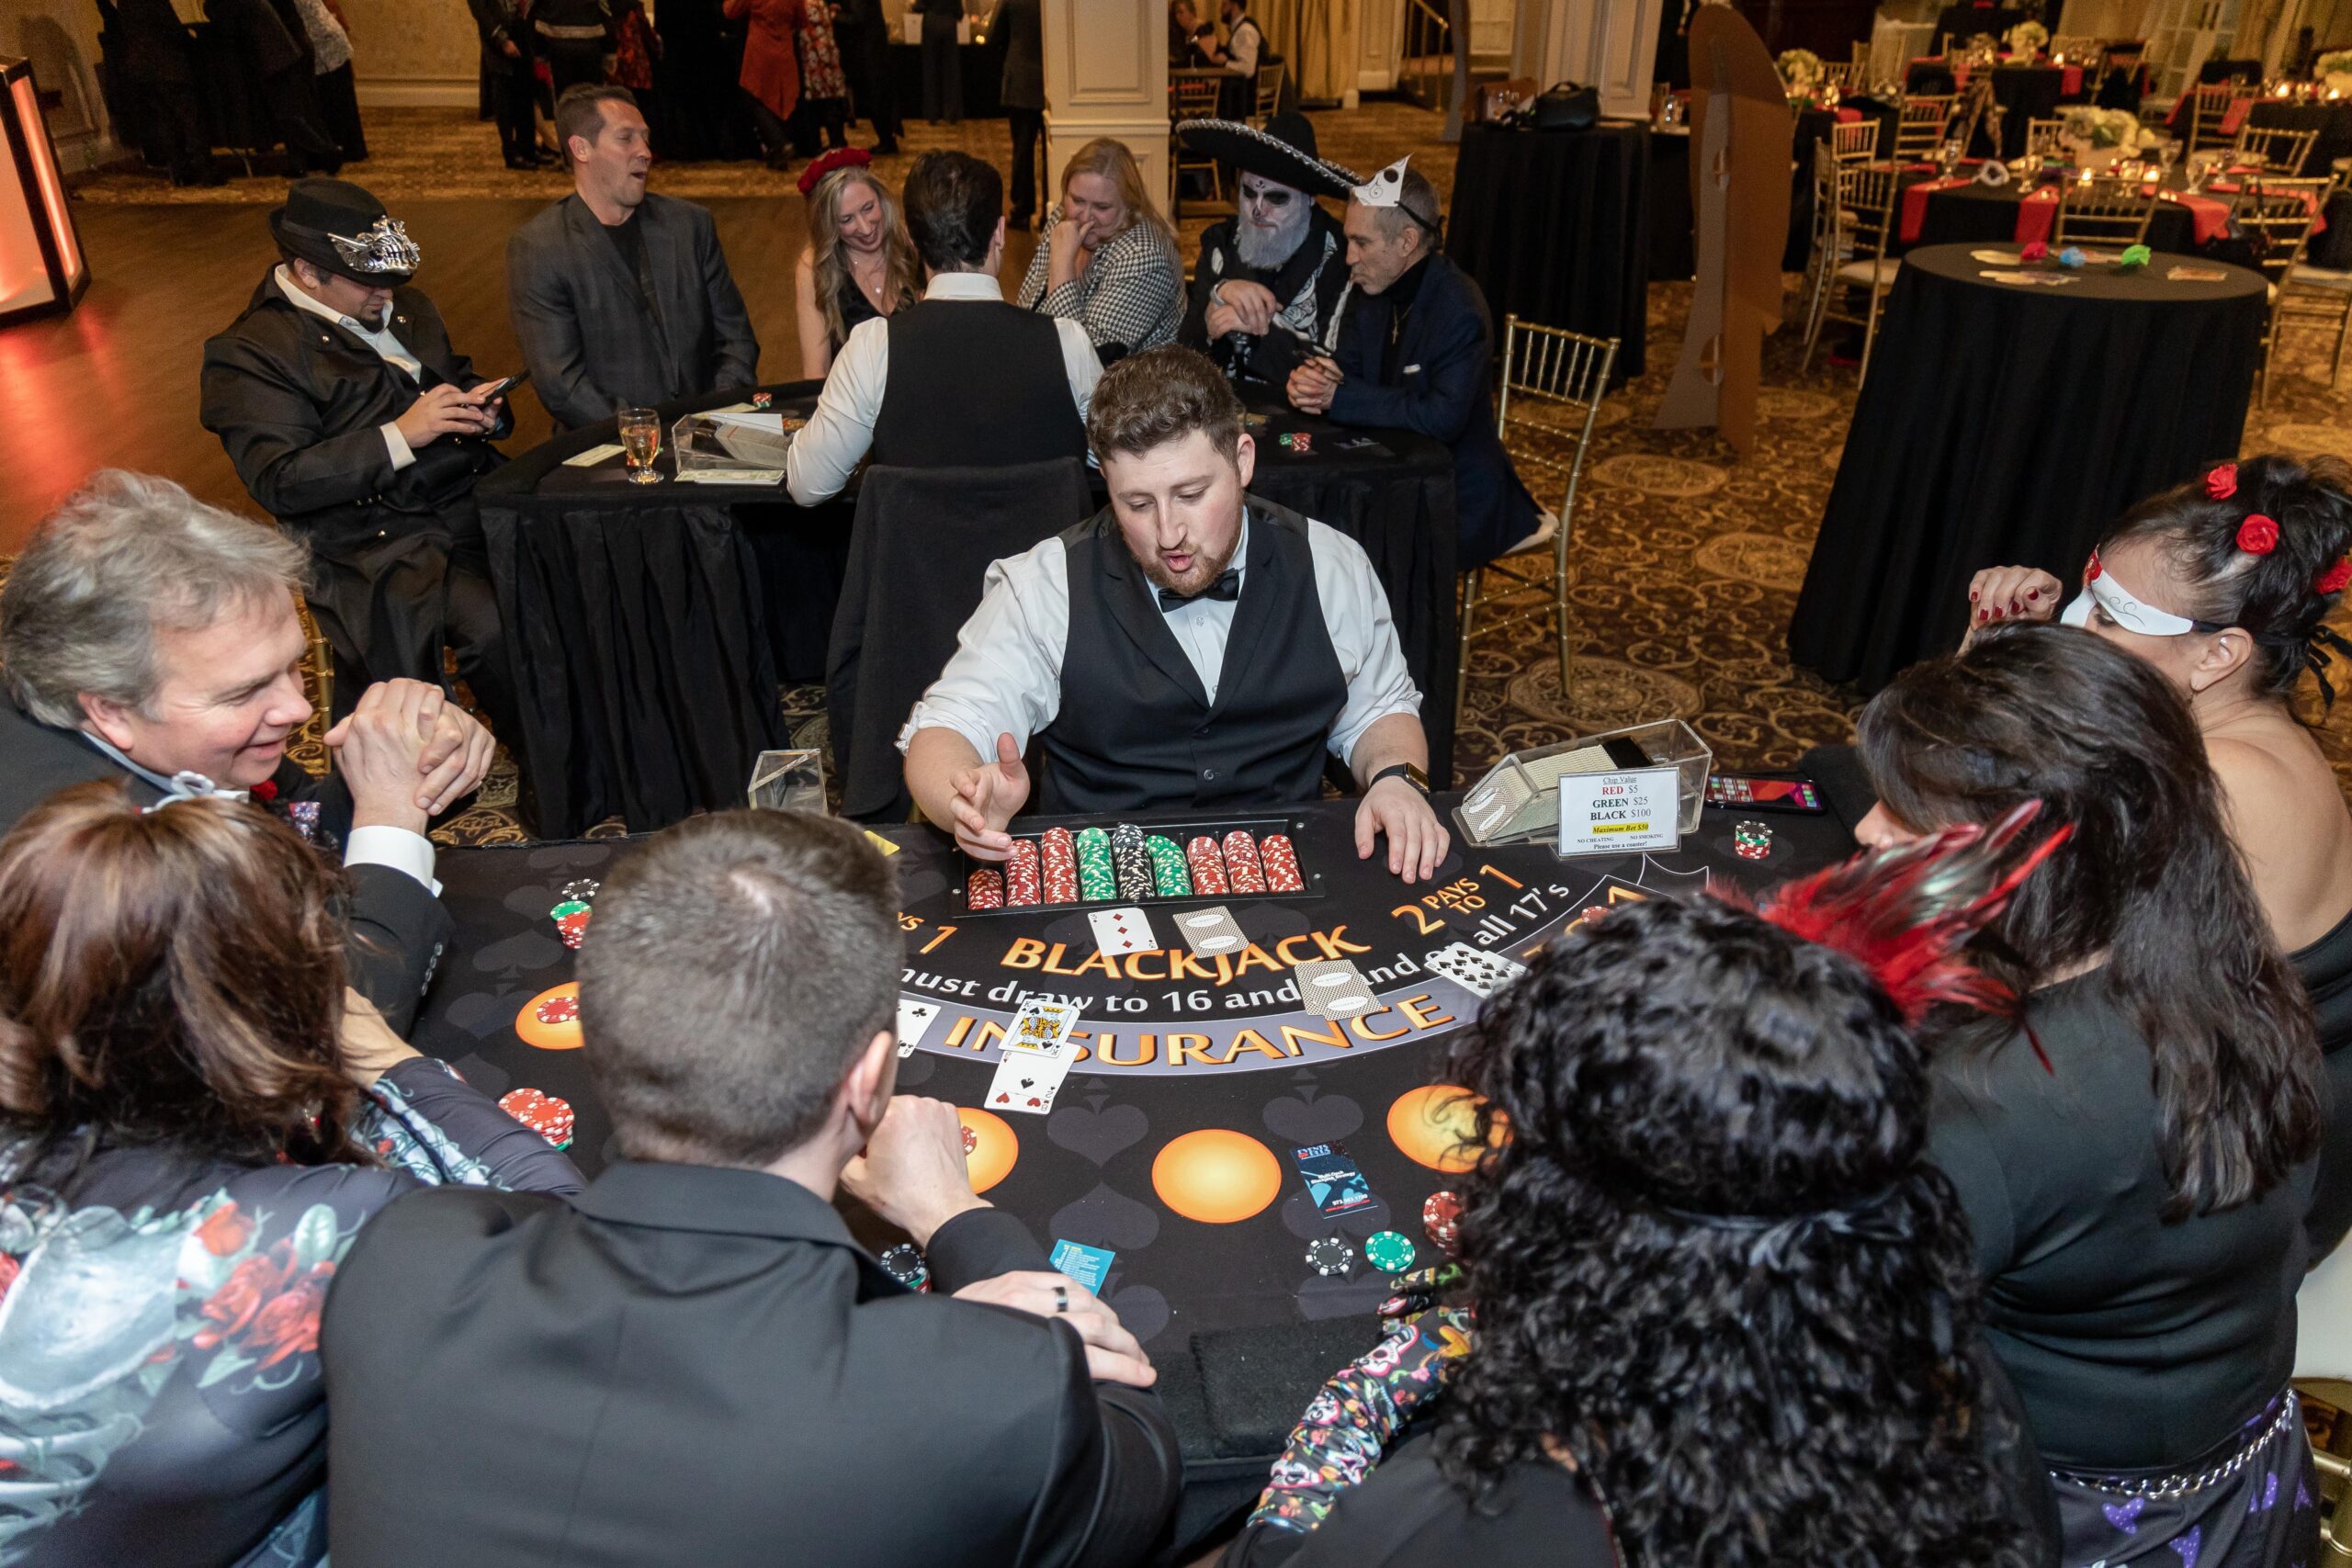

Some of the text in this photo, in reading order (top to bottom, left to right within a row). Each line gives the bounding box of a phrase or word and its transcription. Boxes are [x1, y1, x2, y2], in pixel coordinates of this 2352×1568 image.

[1602, 784, 1638, 795] RED $5
[1592, 796, 1648, 808] GREEN $25
[1590, 808, 1651, 820] BLACK $100
[1592, 823, 1649, 834] Maximum Bet $50
[1391, 864, 1524, 936] 2 PAYS TO 1
[919, 925, 958, 954] 1
[988, 979, 1094, 1010] draw
[1104, 995, 1149, 1012] to
[1161, 989, 1213, 1012] 16
[1225, 978, 1303, 1009] and
[1473, 914, 1518, 946] all
[1001, 924, 1373, 987] BLACKJACK
